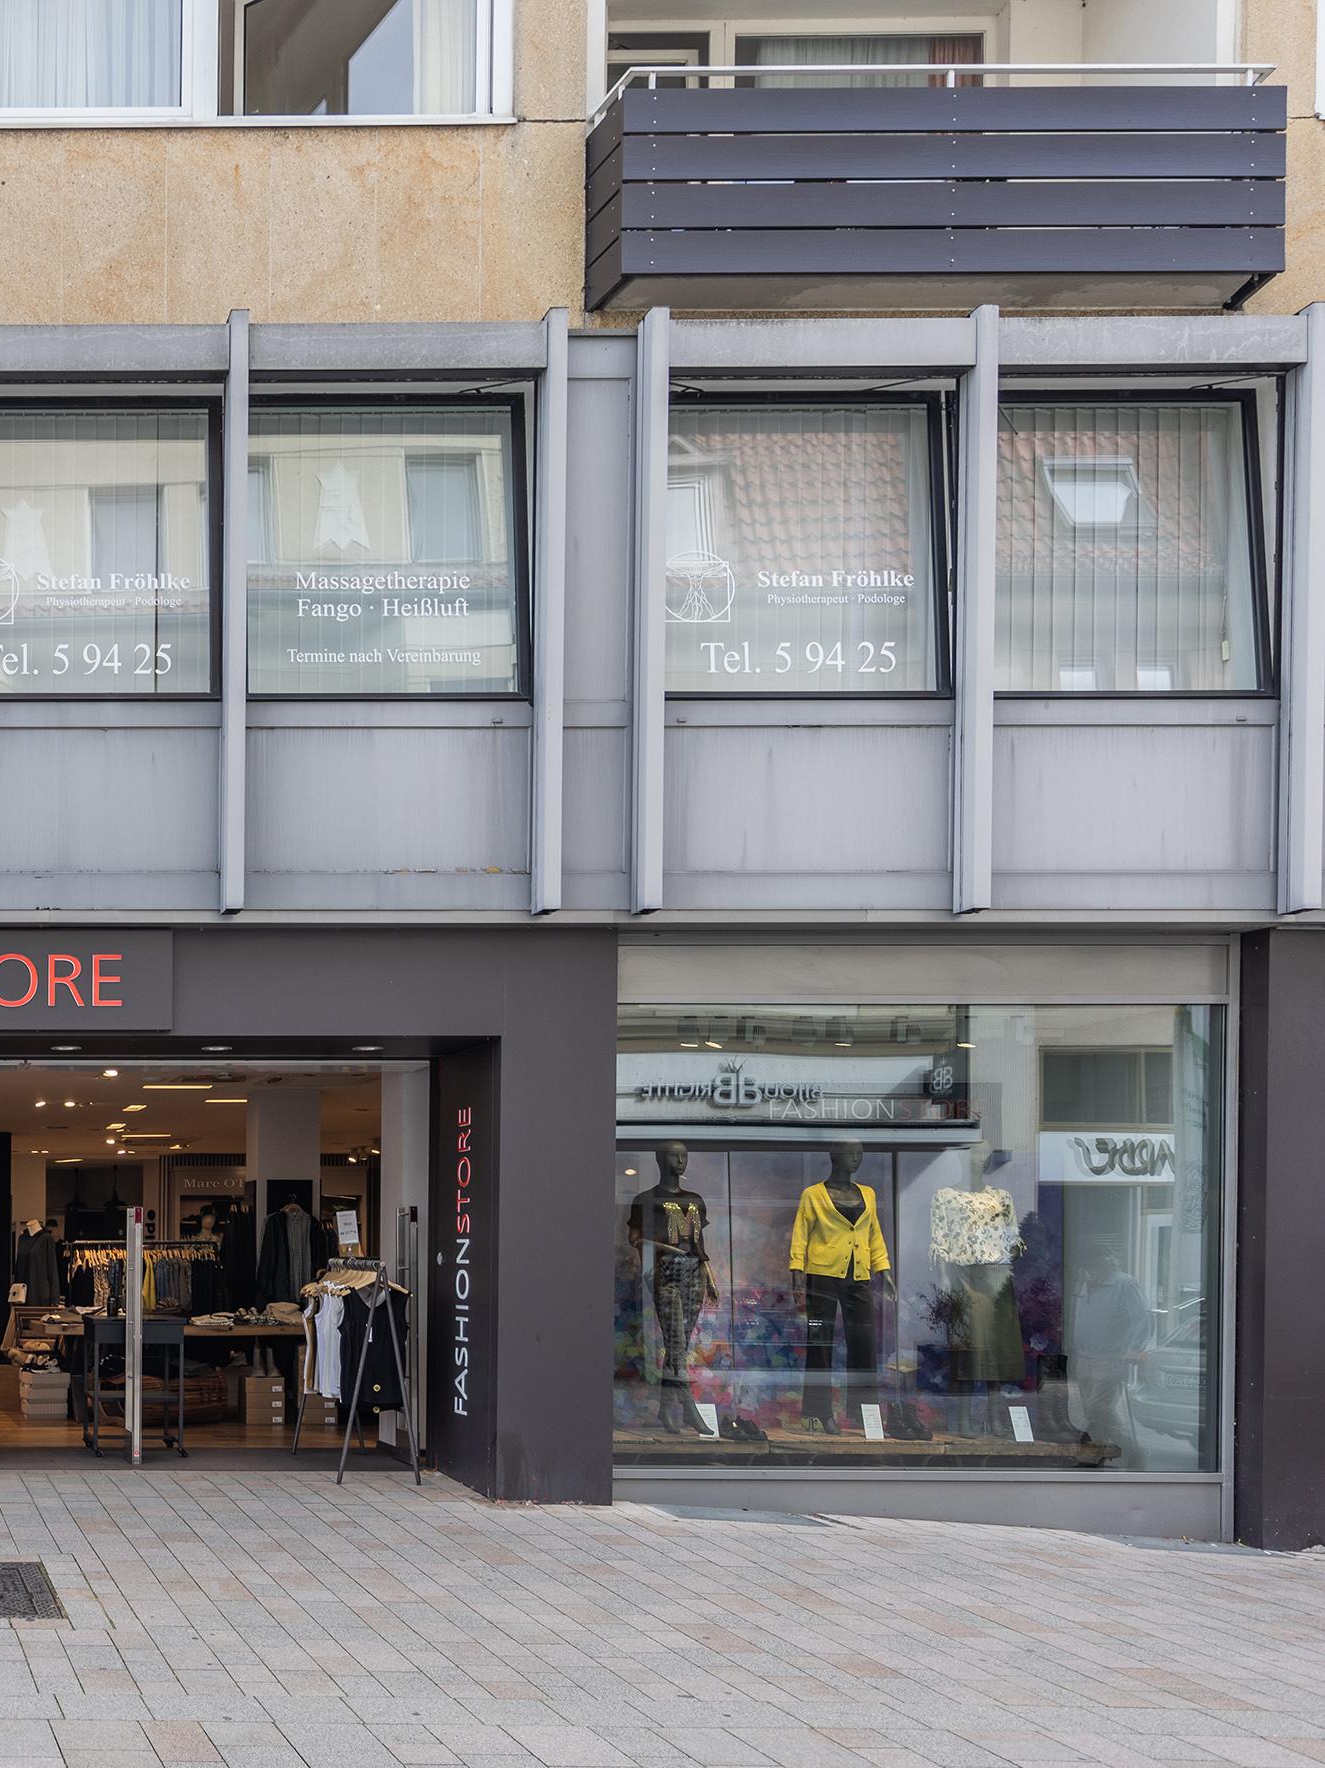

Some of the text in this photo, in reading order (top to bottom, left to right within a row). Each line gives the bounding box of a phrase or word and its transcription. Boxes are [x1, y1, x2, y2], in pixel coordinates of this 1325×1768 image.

[36, 573, 191, 591] Stefan Fröhlke
[295, 570, 471, 594] Massagetherapie
[757, 570, 915, 588] Stefan Fröhlke
[46, 596, 182, 608] Physiotherapeut Podologe
[767, 593, 906, 605] Physiotherapeut Podologe
[296, 597, 470, 622] Fango Heißluft
[52, 643, 70, 676] 5
[82, 643, 122, 676] 94
[133, 643, 172, 676] 25
[286, 648, 482, 665] Termine nach Vereinbarung
[700, 641, 897, 673] Tel. 5 94 25
[183, 1178, 220, 1188] Marc
[453, 1105, 472, 1416] FASHIONSTORE
